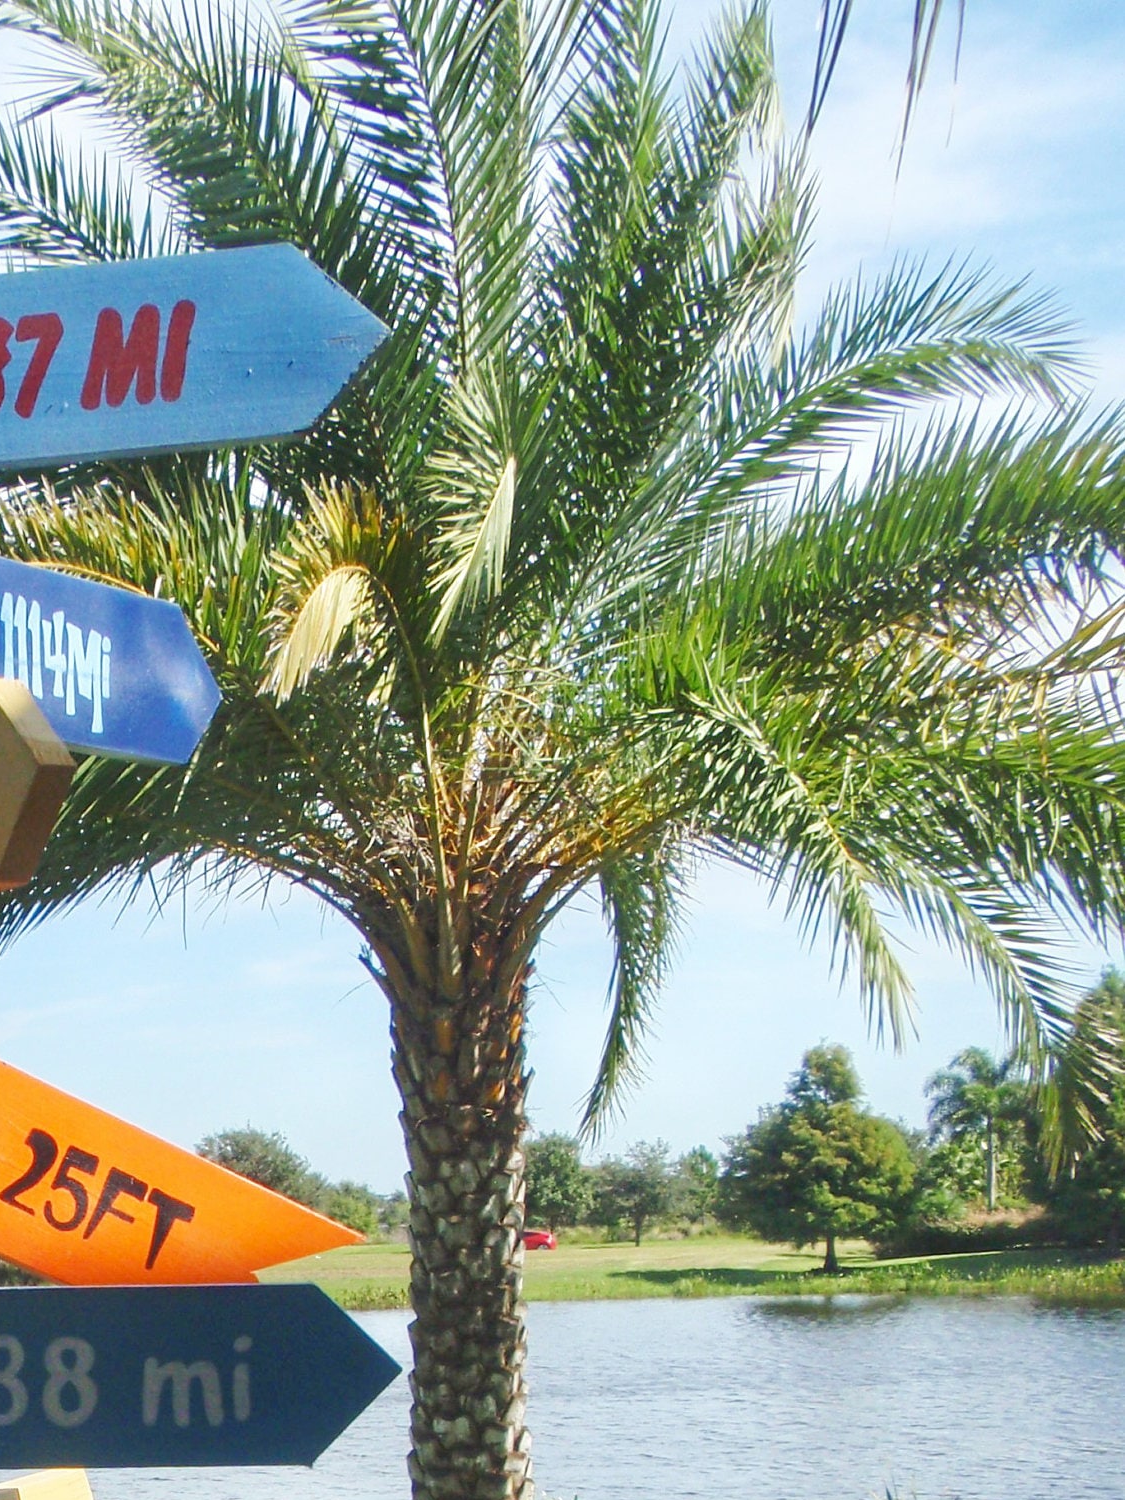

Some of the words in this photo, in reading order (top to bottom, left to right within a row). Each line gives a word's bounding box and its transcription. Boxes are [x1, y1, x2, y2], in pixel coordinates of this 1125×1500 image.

[80, 300, 196, 411] MI
[0, 1127, 196, 1270] 25FT
[142, 1335, 253, 1427] mi
